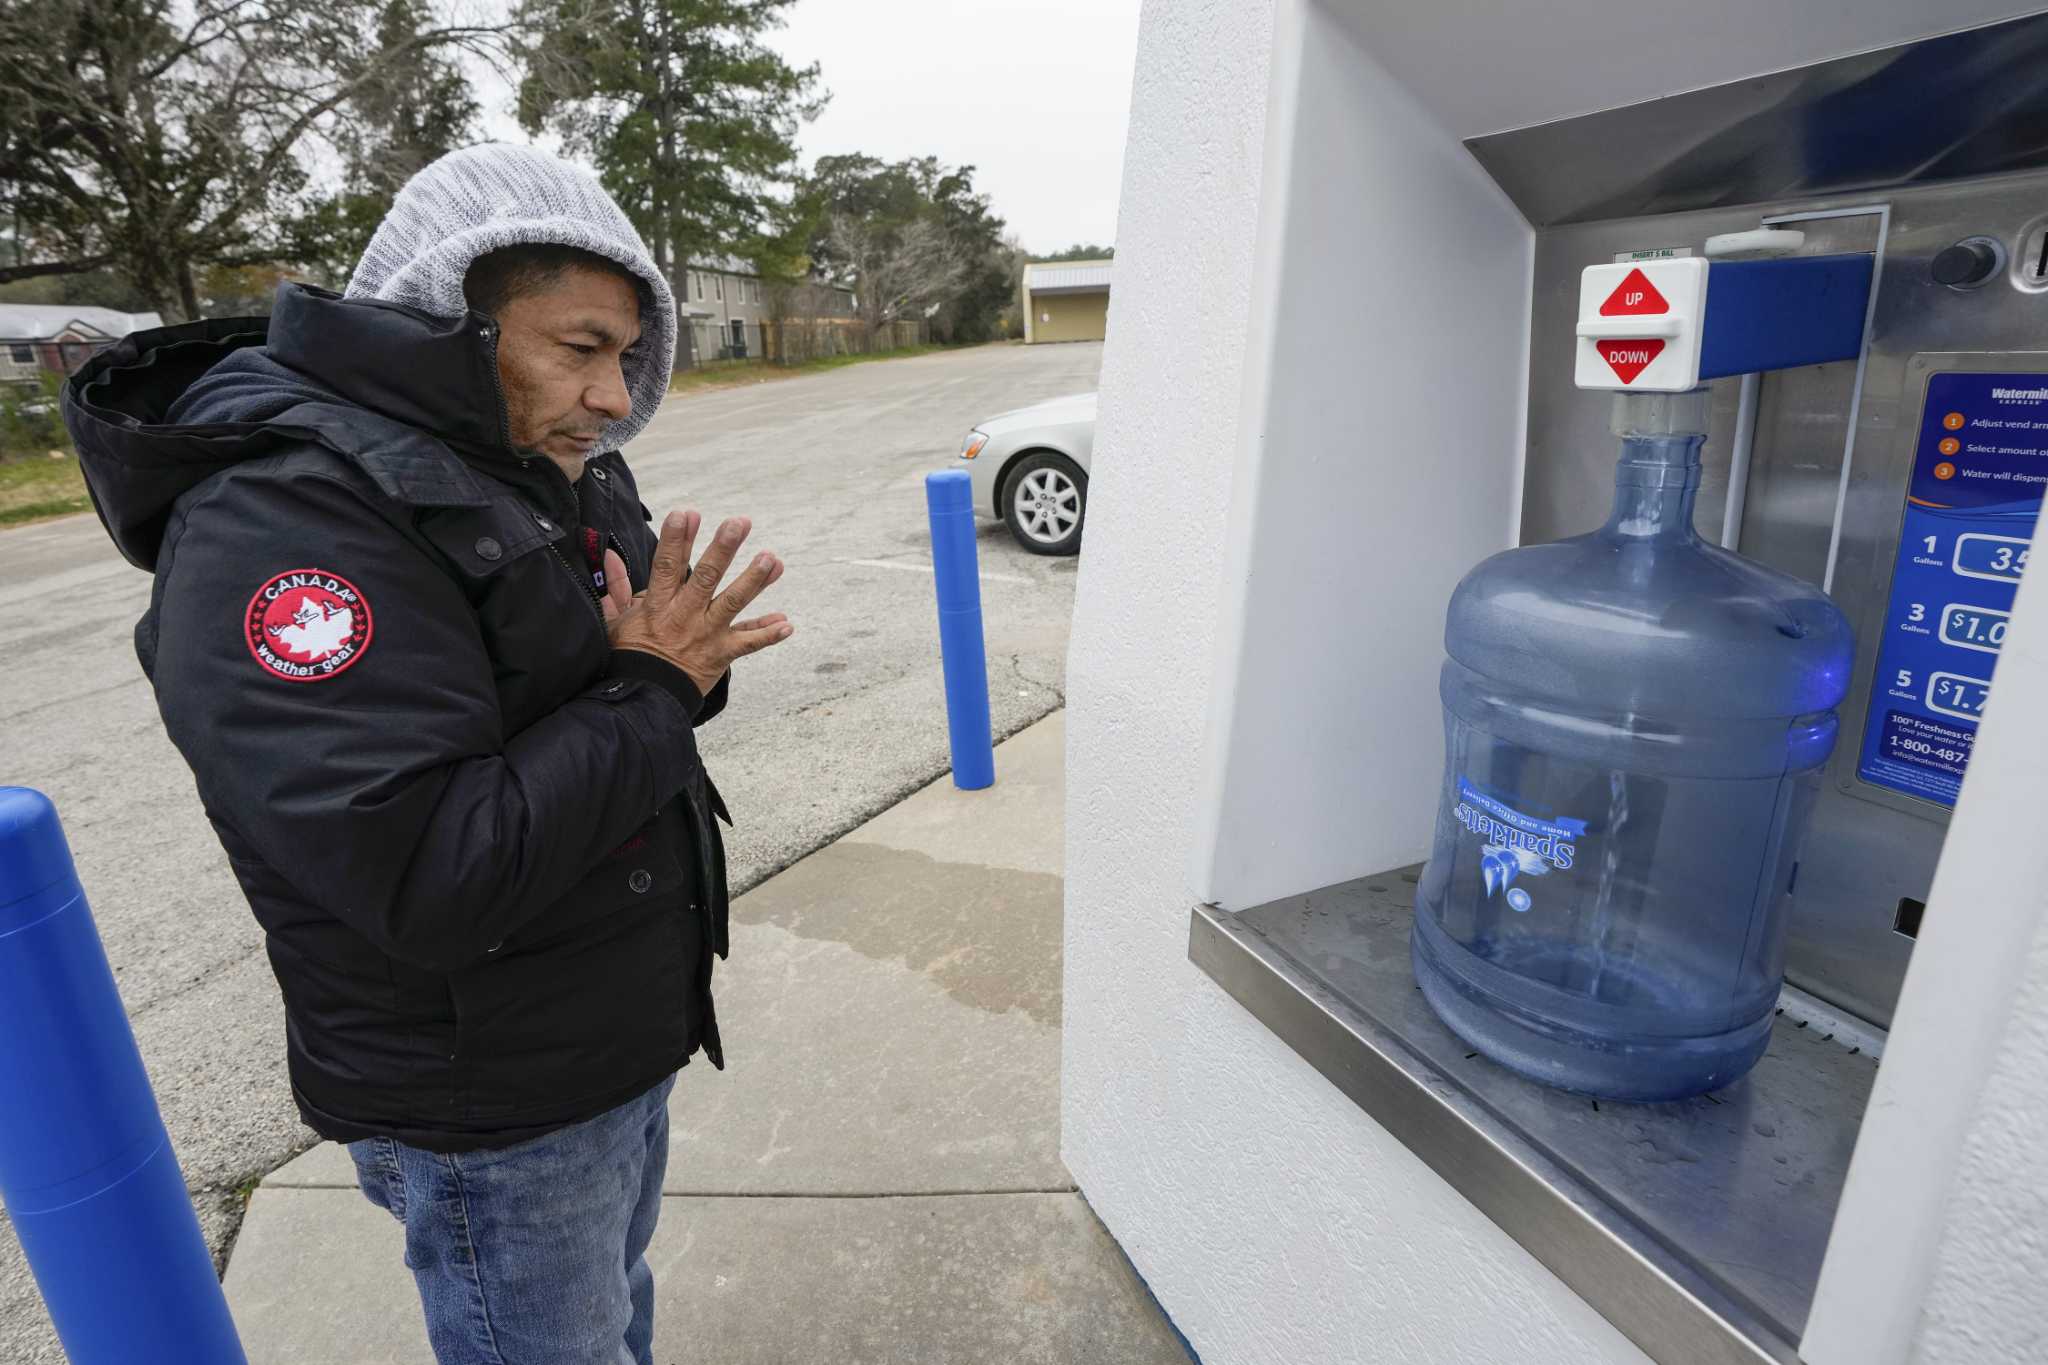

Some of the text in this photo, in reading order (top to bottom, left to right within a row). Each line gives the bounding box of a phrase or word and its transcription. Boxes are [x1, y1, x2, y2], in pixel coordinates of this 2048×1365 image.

[1625, 292, 1643, 305] UP
[1609, 351, 1648, 365] DOWN
[1950, 417, 1956, 426] 1
[1971, 418, 2003, 430] Adjust
[2005, 420, 2030, 429] vend
[1945, 443, 1953, 451] 2
[1967, 443, 1996, 454] Select
[1998, 446, 2037, 456] amount
[1940, 467, 1948, 476] 3
[1962, 469, 1991, 480] Water
[1993, 470, 2011, 481] will
[1923, 535, 1937, 553] 1
[1913, 556, 1943, 567] Gallons
[1908, 603, 1925, 621] 3
[1900, 623, 1930, 635] Gallons
[257, 643, 355, 676] weather gear
[1896, 669, 1912, 687] 5
[1888, 689, 1917, 701] Gallons
[1914, 720, 1962, 740] Freshness
[1915, 729, 1933, 741] your
[1934, 734, 1957, 746] water
[1492, 804, 1517, 822] Office
[1520, 819, 1538, 829] and
[1456, 803, 1575, 870] Sparkletts
[1541, 826, 1571, 838] Home
